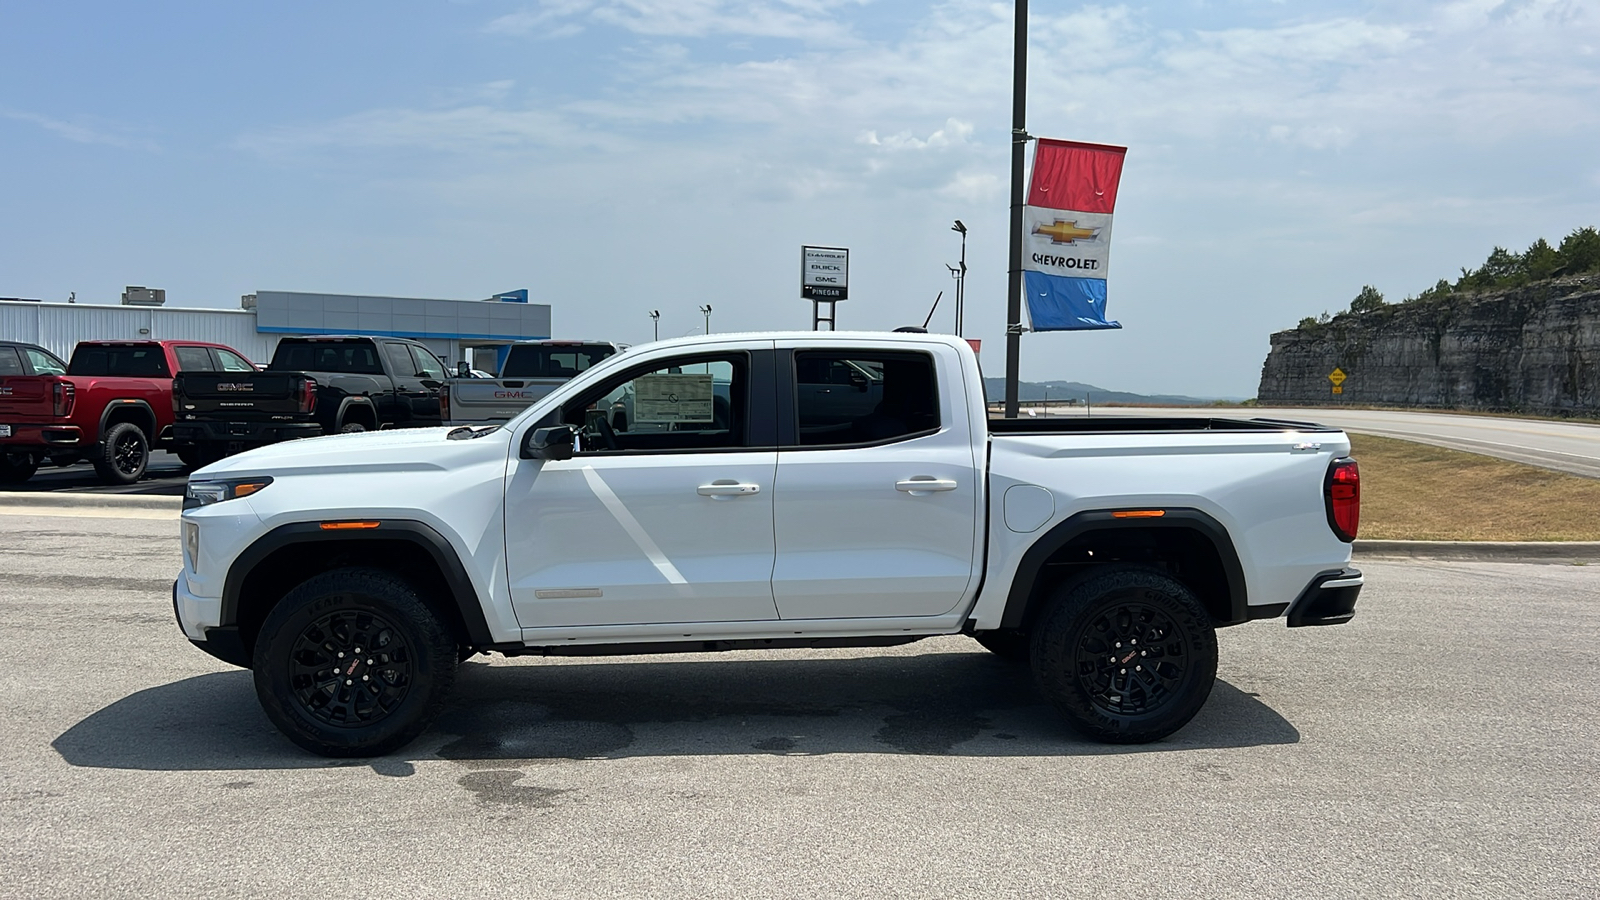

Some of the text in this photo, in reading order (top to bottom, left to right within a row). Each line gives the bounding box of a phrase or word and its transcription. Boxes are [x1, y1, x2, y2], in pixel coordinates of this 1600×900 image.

[1032, 252, 1097, 270] CHEVROLET
[811, 288, 840, 296] PINEGAR
[216, 382, 254, 392] GMC
[494, 390, 533, 399] GMC
